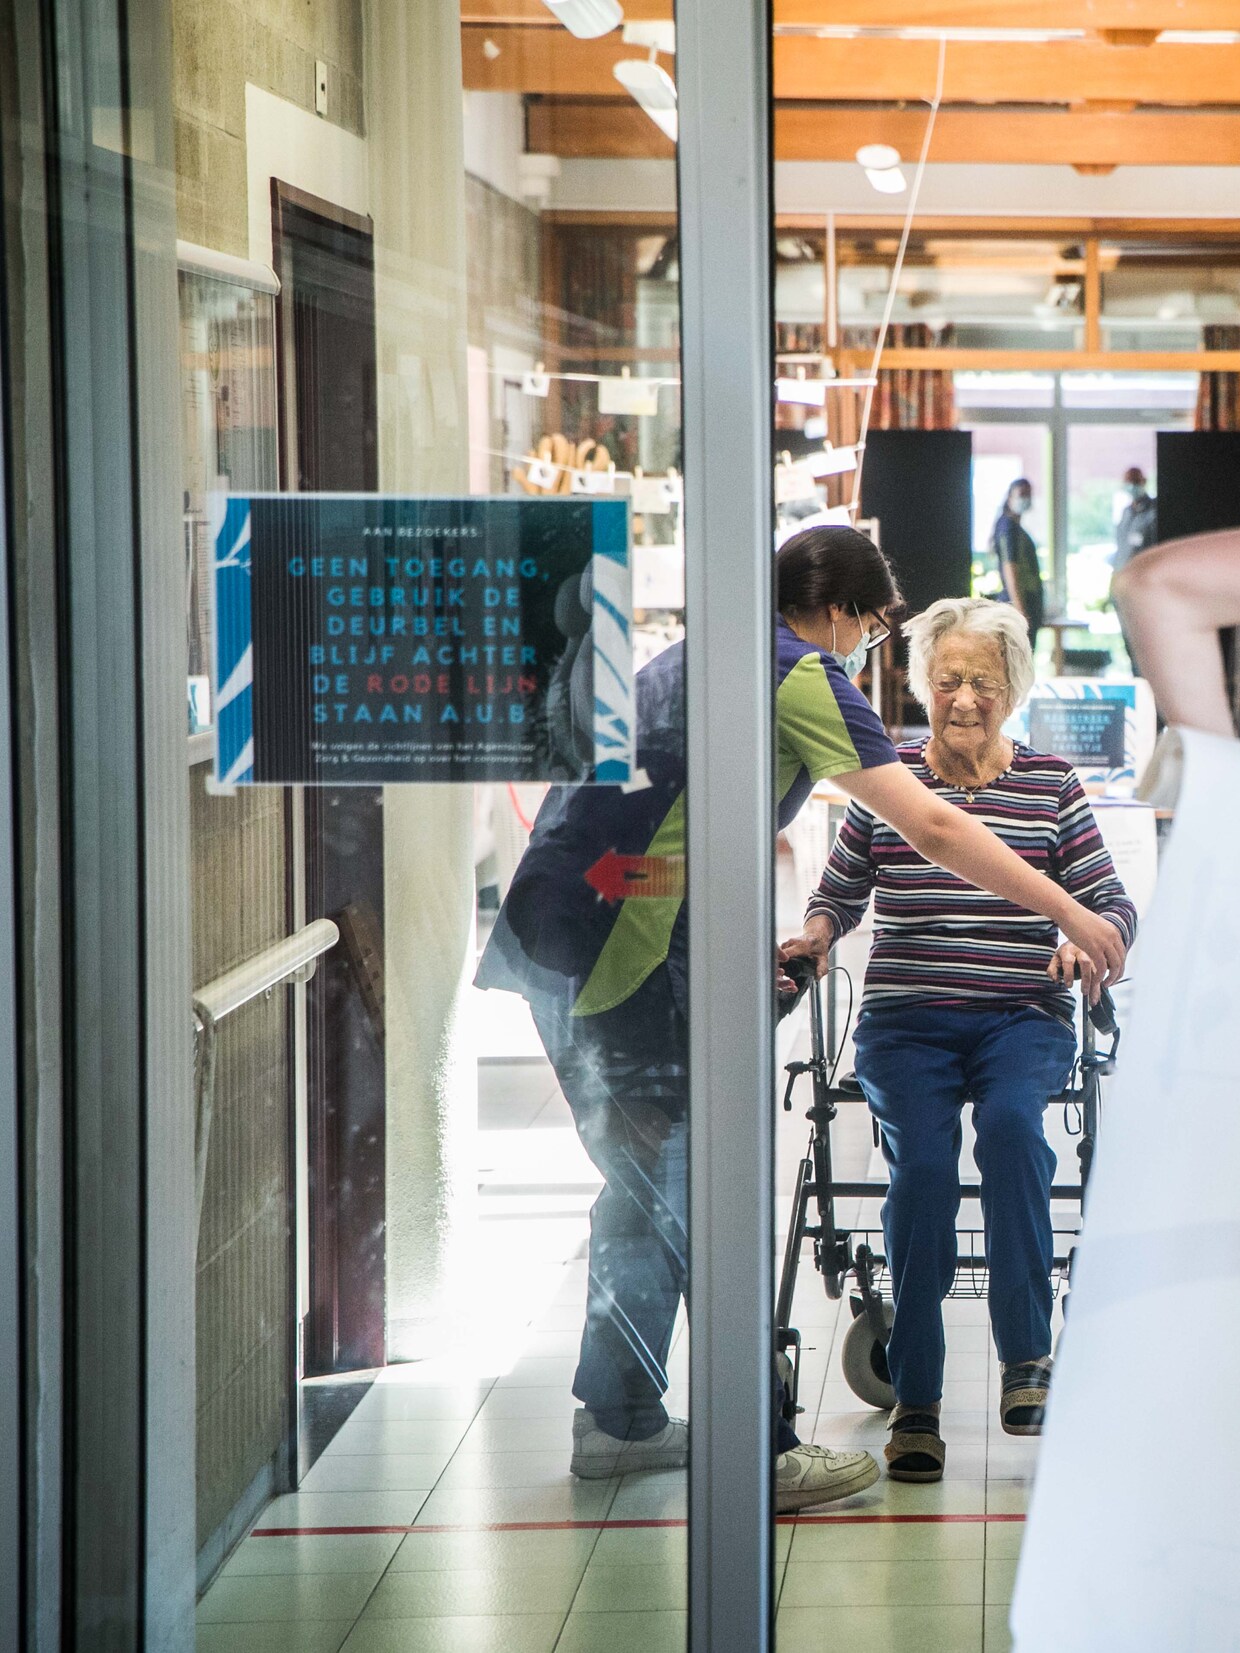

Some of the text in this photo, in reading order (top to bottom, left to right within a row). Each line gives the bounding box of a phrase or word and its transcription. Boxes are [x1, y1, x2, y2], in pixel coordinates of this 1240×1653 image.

[362, 527, 393, 537] AAN
[288, 557, 549, 580] GEEN TOEGANG,
[326, 587, 520, 607] GEBRUIK DE
[327, 616, 520, 636] DEURBEL EN
[310, 645, 537, 665] BLIJF ACHTER
[313, 674, 537, 694] DE RODE LIJN
[313, 703, 423, 724] STAAN
[312, 742, 327, 751] We
[330, 742, 364, 753] volgen
[367, 742, 380, 751] de
[315, 754, 338, 764] Zorg
